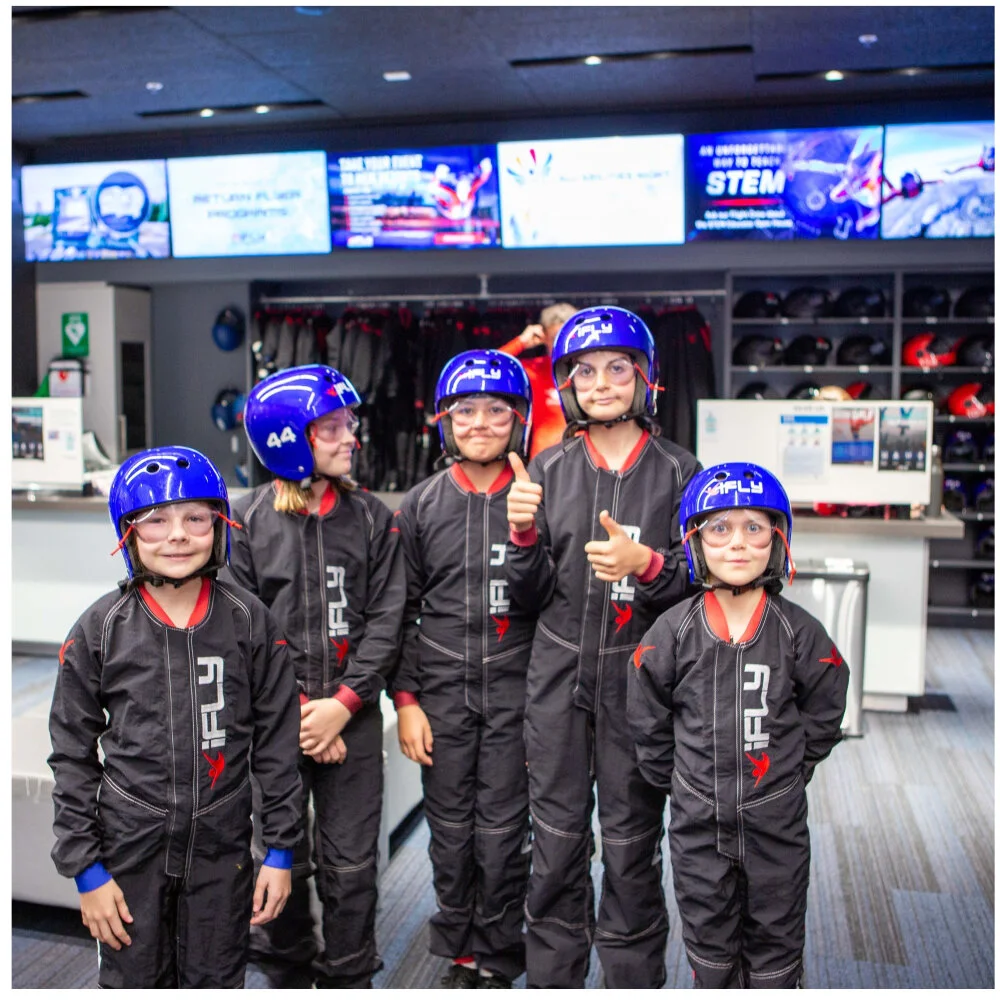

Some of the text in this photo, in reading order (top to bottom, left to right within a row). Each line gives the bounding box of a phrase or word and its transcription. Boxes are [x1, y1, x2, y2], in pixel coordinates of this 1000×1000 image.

[706, 169, 785, 195] STEM
[267, 426, 297, 448] 44
[718, 479, 763, 494] iFLY
[326, 565, 350, 637] iFLY
[197, 656, 227, 751] iFLY
[744, 663, 770, 751] iFLY
